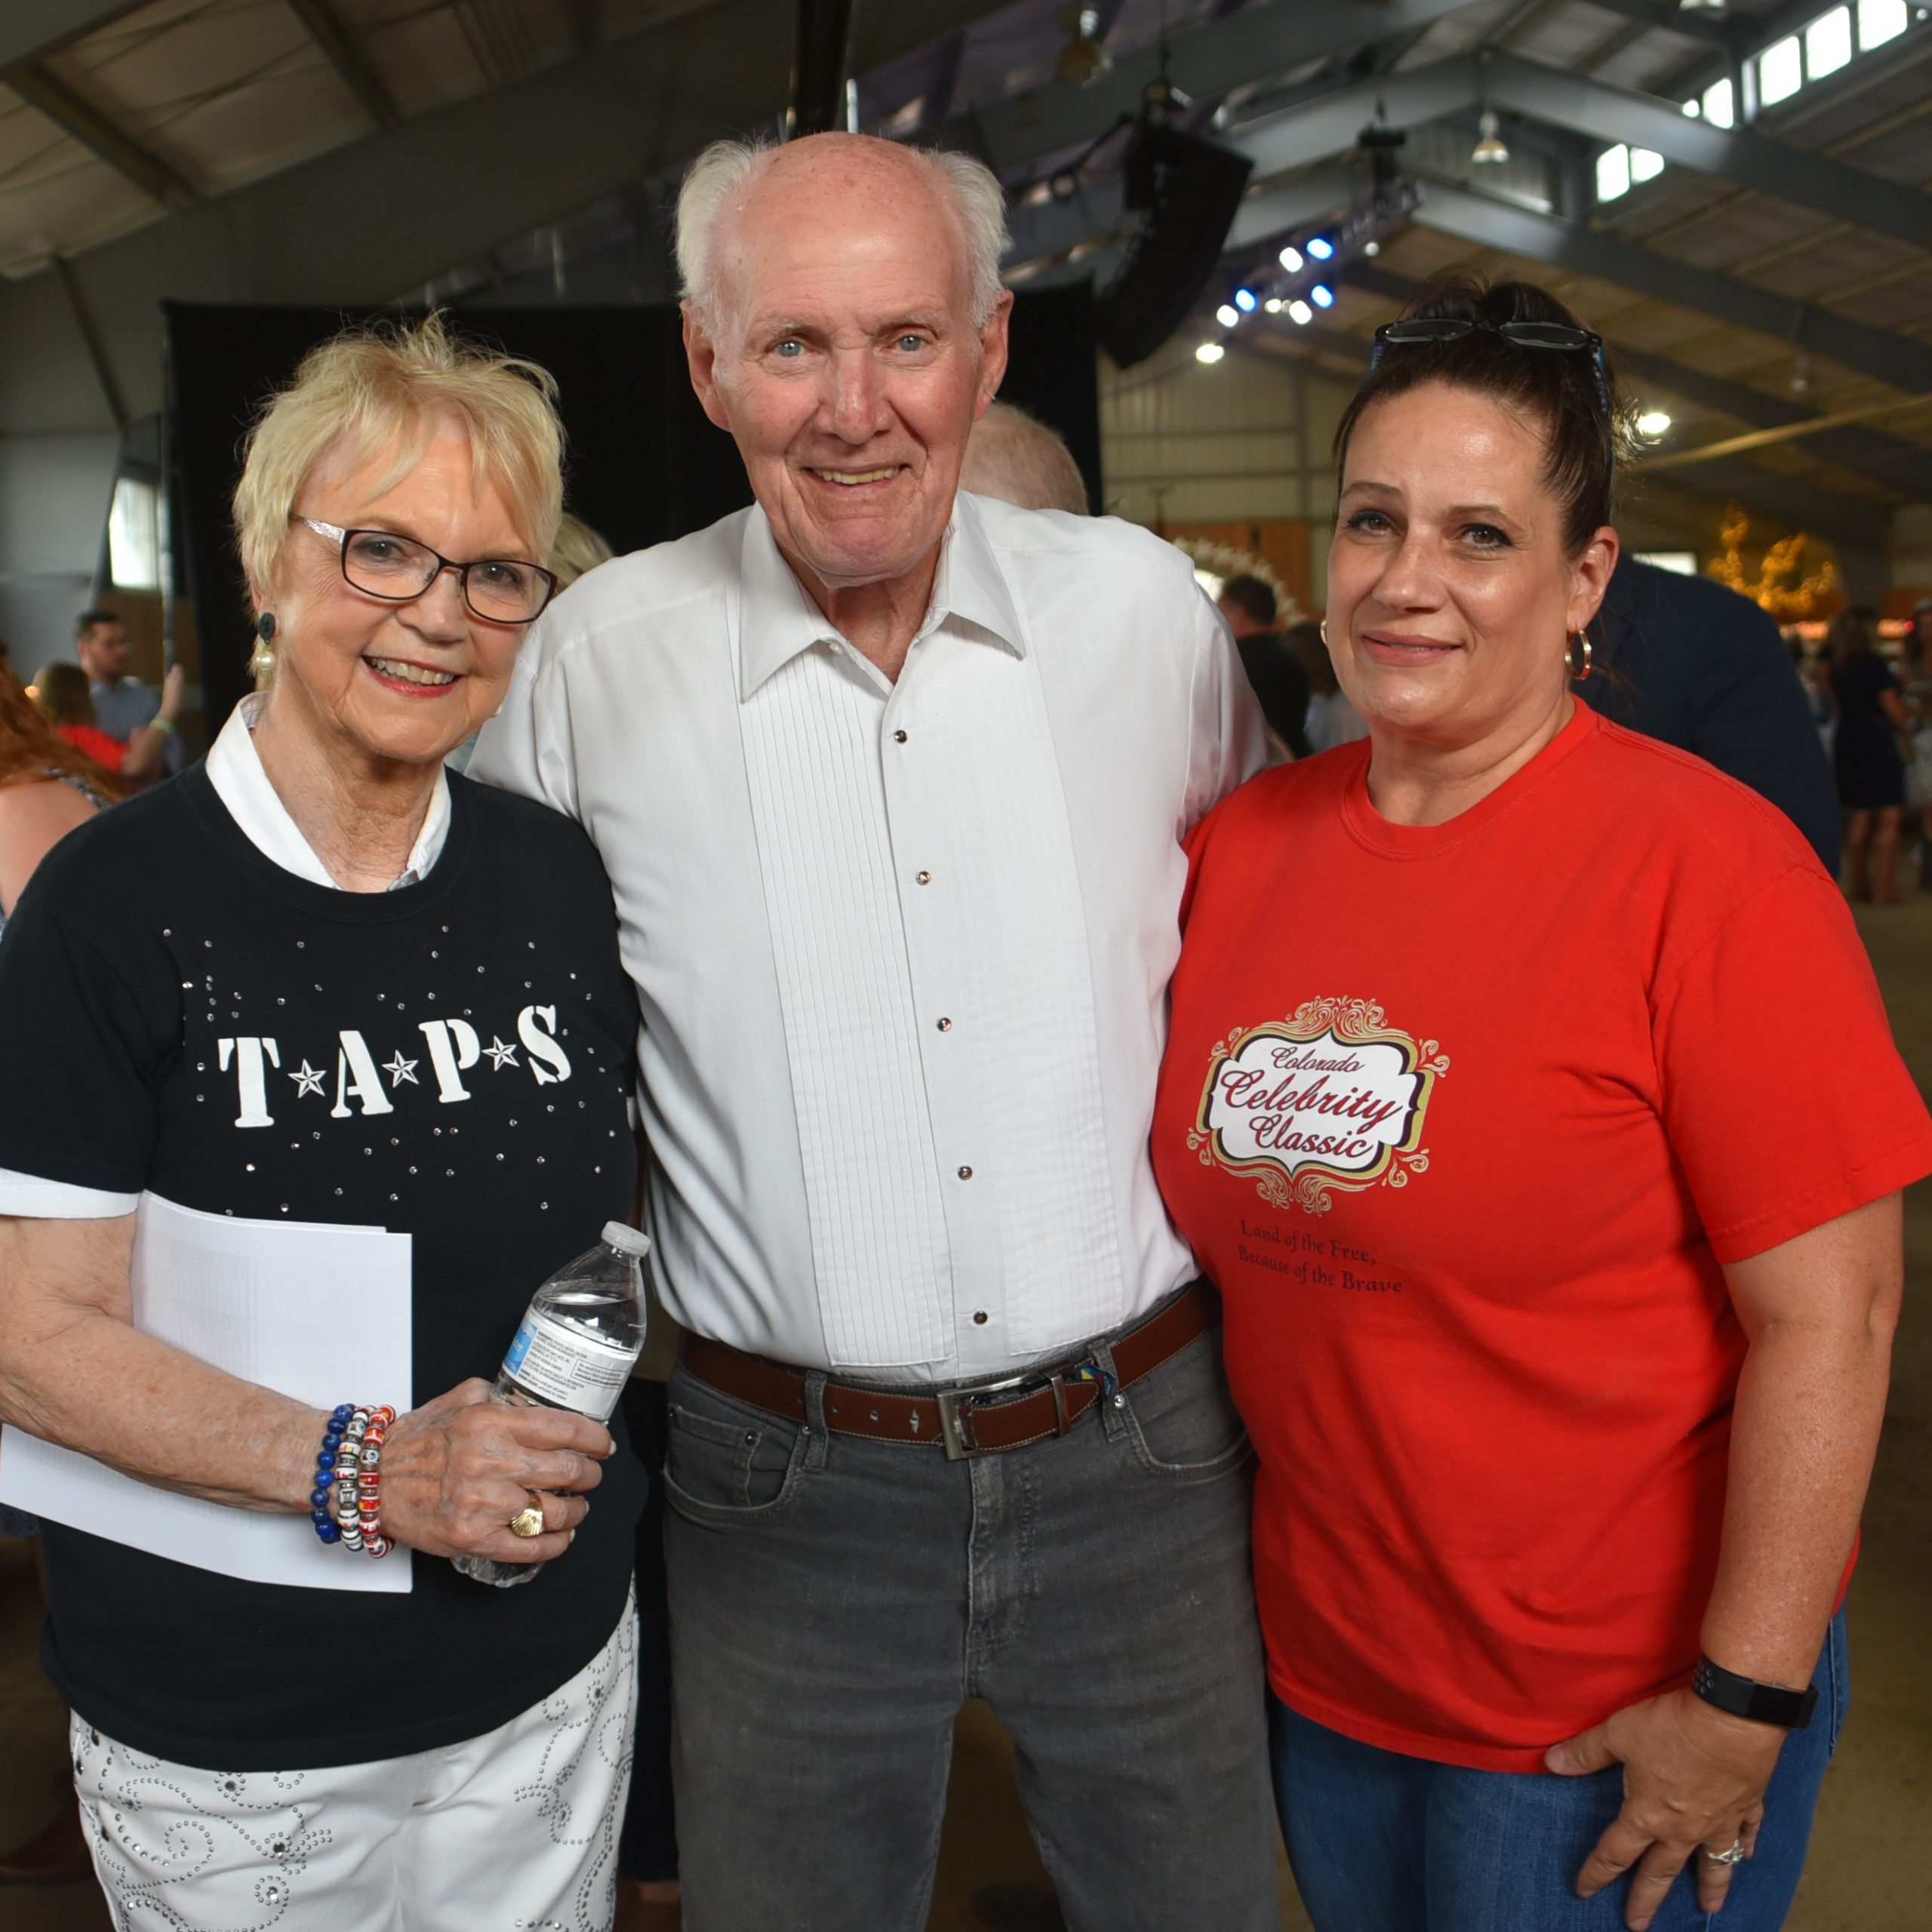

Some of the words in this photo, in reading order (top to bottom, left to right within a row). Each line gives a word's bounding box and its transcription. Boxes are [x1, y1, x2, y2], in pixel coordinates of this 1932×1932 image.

[1271, 1047, 1365, 1072] Colorado
[1220, 1069, 1403, 1134] Celebrity
[1249, 1114, 1374, 1158] Classic
[1240, 1220, 1280, 1243] Land
[1284, 1230, 1298, 1253] of
[1302, 1234, 1324, 1254] the
[1330, 1238, 1377, 1265] Free,
[1238, 1244, 1290, 1274] Because
[1294, 1262, 1308, 1284] of
[1312, 1266, 1335, 1285] the
[1341, 1270, 1402, 1293] Brave
